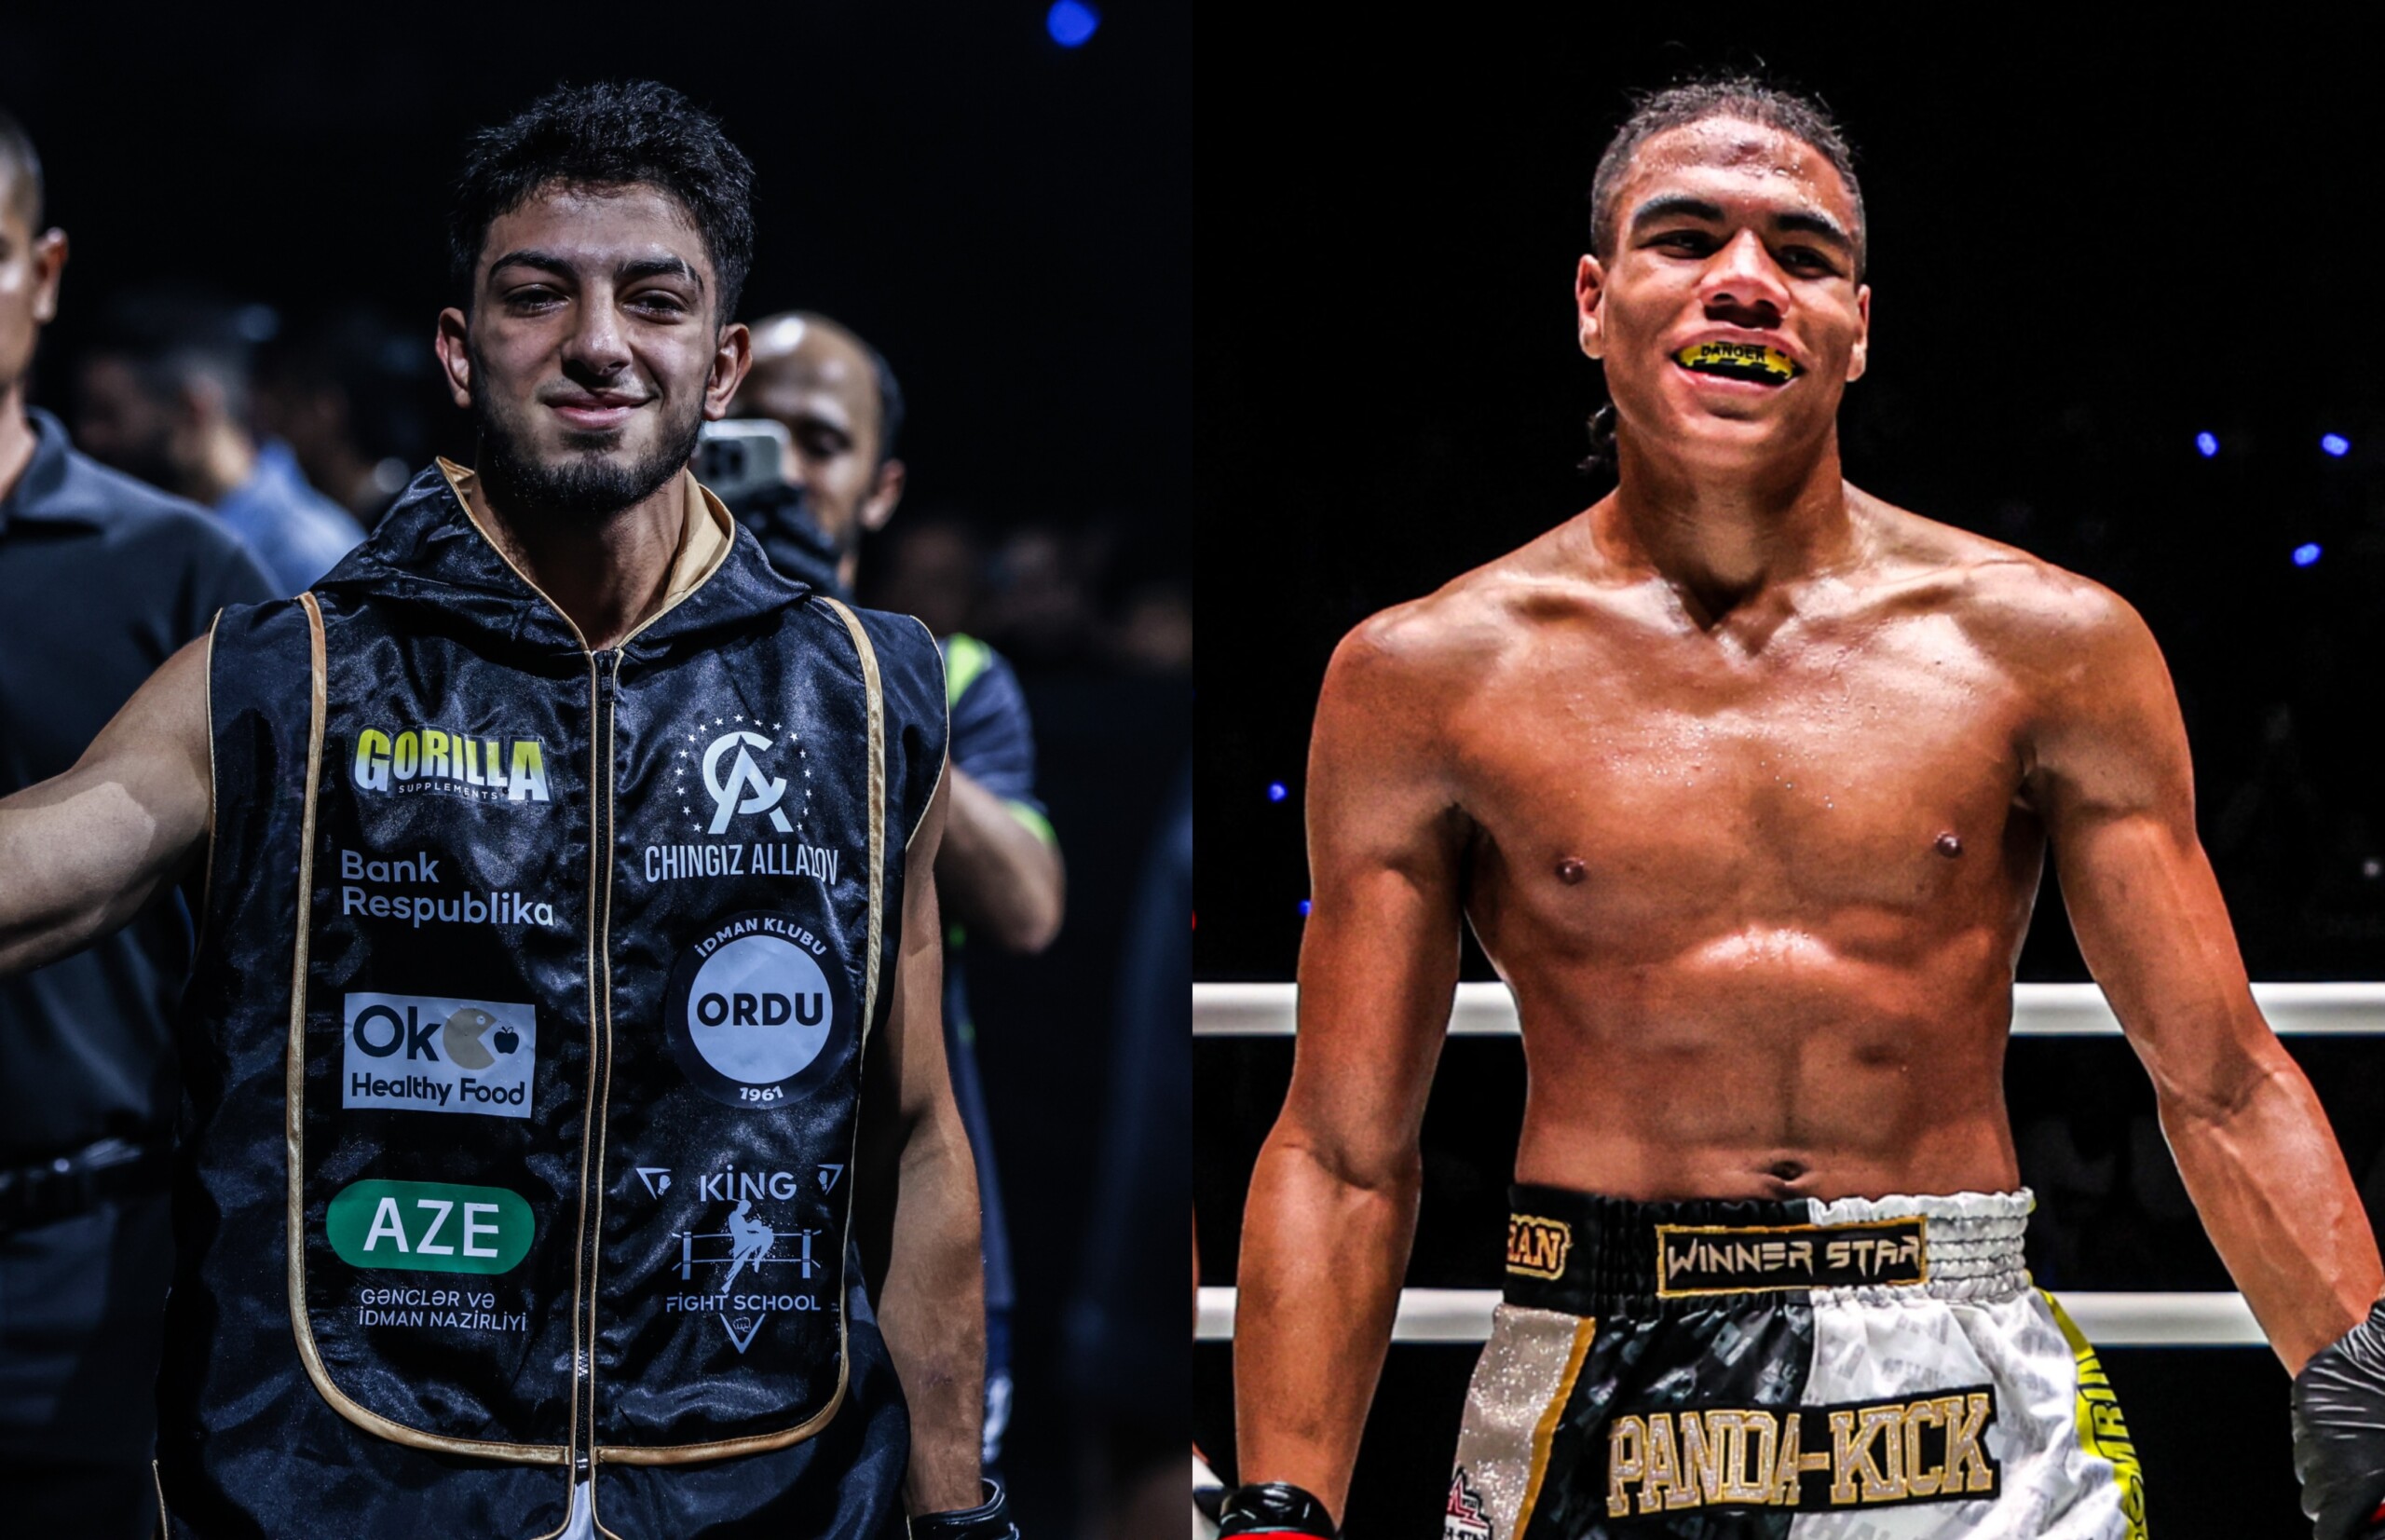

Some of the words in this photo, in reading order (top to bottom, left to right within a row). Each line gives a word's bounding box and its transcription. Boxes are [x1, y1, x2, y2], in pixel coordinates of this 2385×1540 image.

[1700, 345, 1765, 361] DANGER
[353, 728, 550, 801] GORILLA
[398, 782, 497, 800] SUPPLEMENTS
[341, 849, 439, 883] Bank
[645, 844, 744, 883] CHINGIZ
[342, 886, 554, 929] Respublika
[764, 918, 827, 956] KLUBU
[697, 992, 824, 1028] ORDU
[351, 1072, 453, 1107] Healthy
[460, 1077, 525, 1106] Food
[739, 1085, 784, 1102] 1961
[362, 1197, 499, 1258] AZE
[1667, 1237, 1814, 1280] WINNER
[1826, 1235, 1921, 1277] STAR
[361, 1288, 460, 1307] GƏNCLƏR
[467, 1292, 496, 1309] VƏ
[733, 1294, 822, 1312] SCHOOL
[1606, 1393, 1994, 1519] PANDA-KICK
